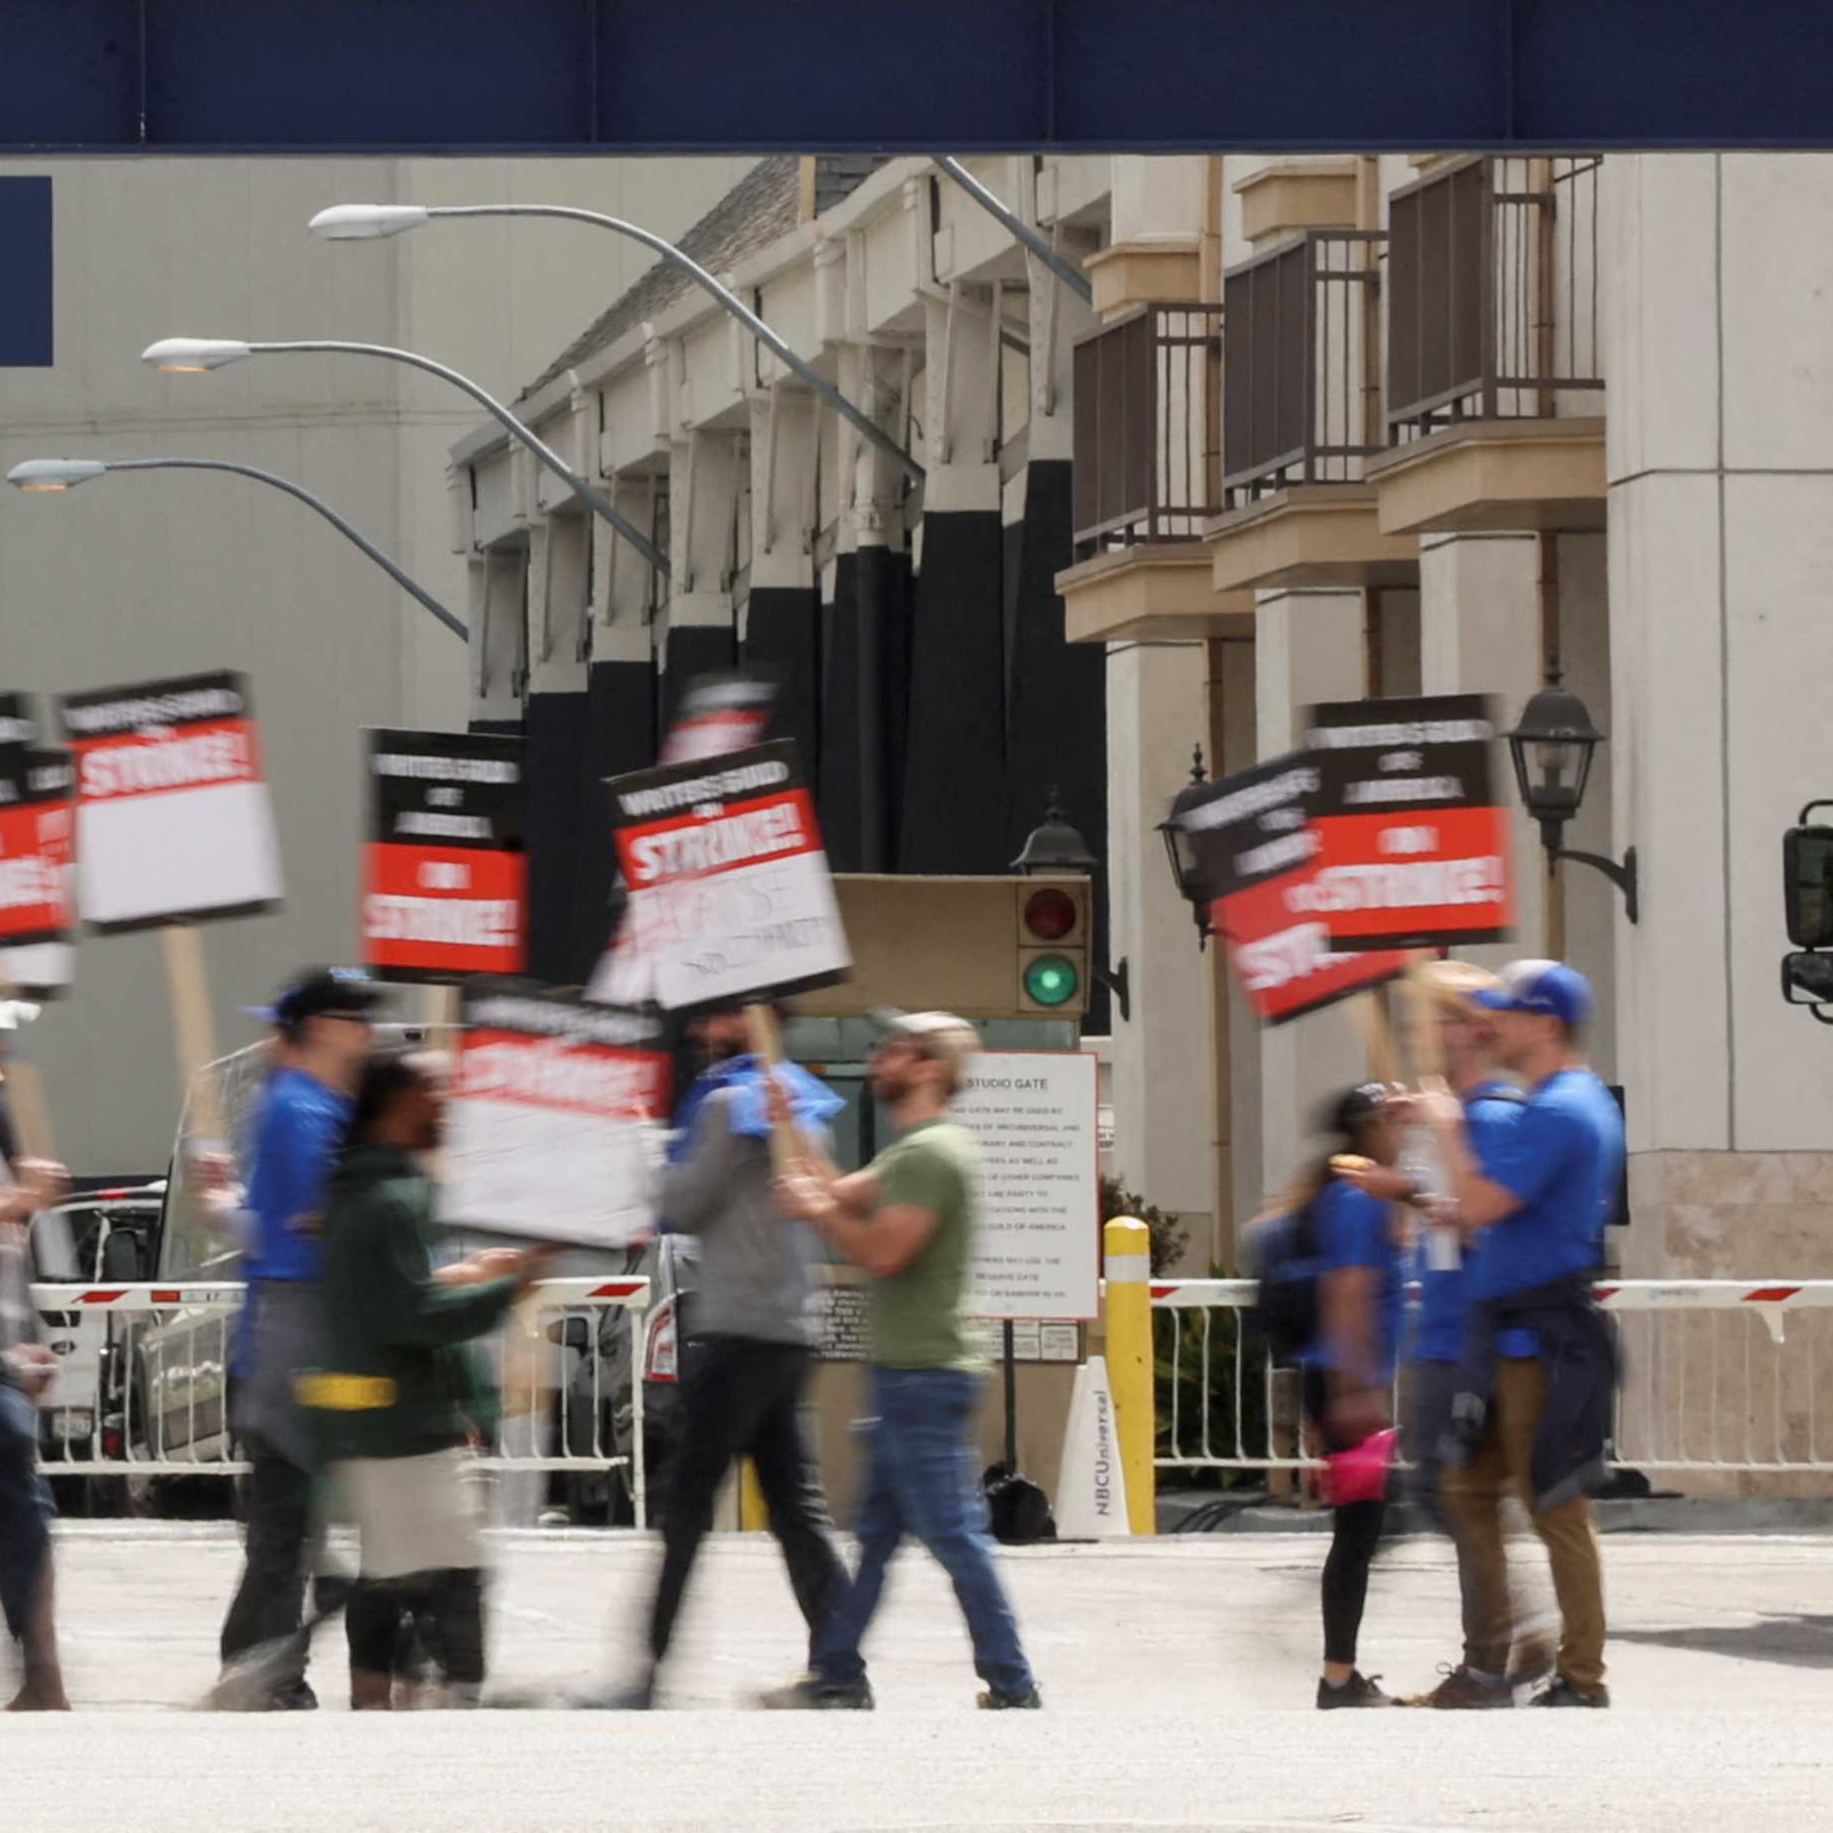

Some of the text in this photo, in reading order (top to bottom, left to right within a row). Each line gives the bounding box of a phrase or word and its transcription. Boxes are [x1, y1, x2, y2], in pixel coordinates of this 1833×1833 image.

[629, 802, 806, 881] STRIKE!
[966, 1078, 1048, 1089] STUDIO GATE
[1094, 1390, 1110, 1516] NBCUniversal
